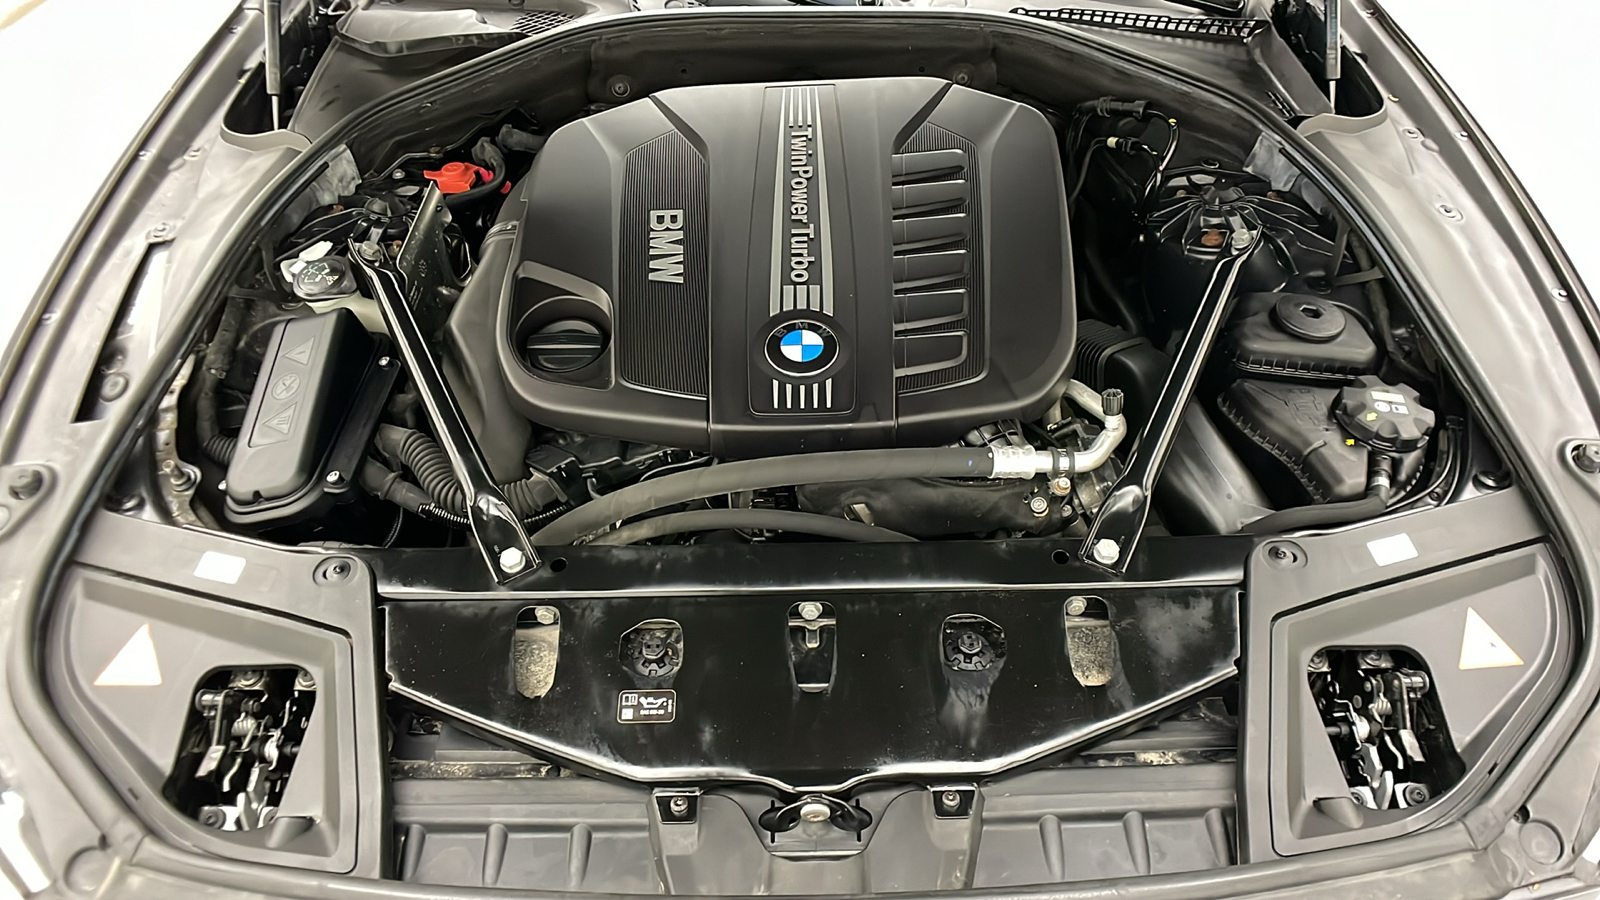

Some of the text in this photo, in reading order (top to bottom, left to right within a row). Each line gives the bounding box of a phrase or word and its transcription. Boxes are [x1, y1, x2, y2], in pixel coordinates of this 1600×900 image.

[790, 127, 815, 283] TwinPower Turbo
[648, 209, 684, 284] BMW
[774, 322, 831, 338] BMW
